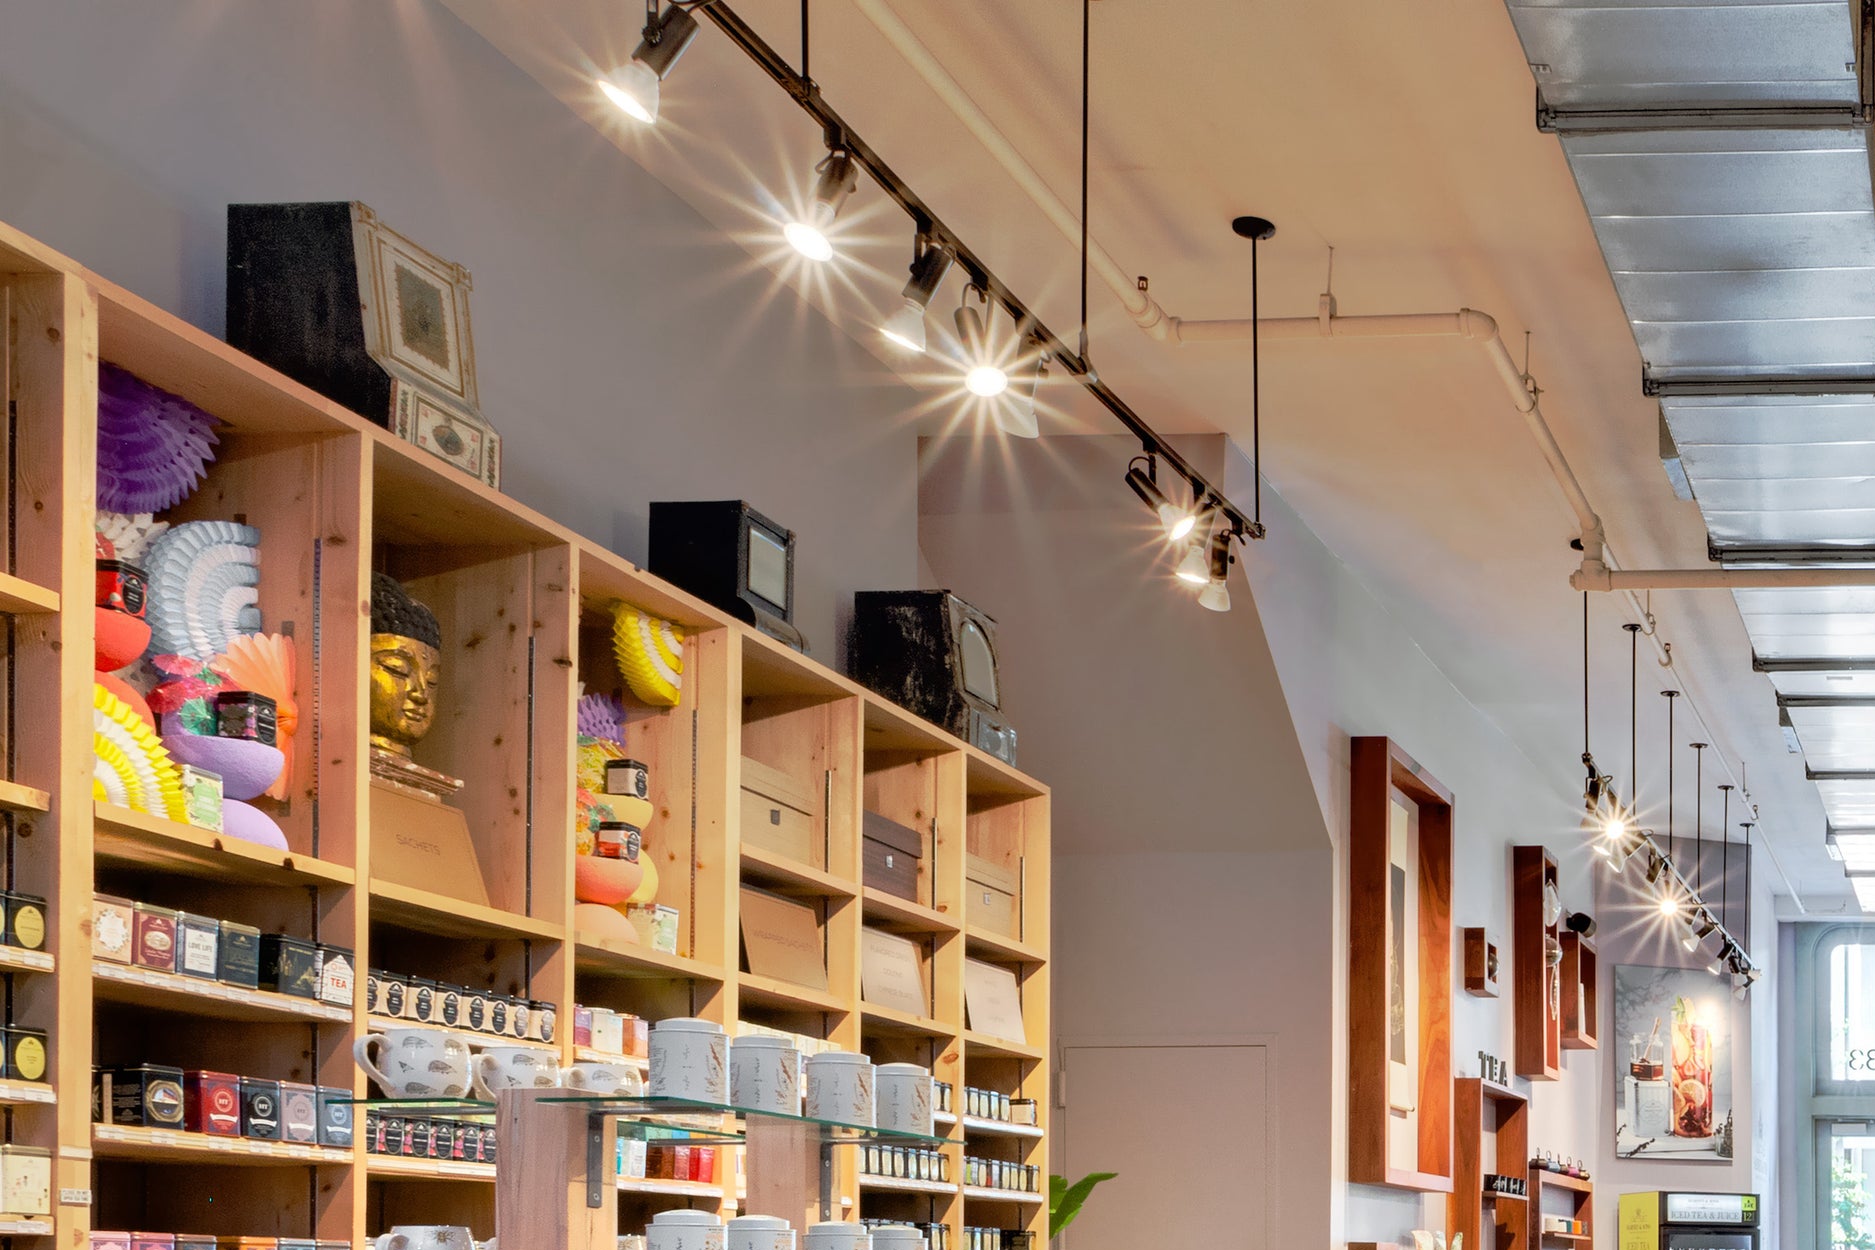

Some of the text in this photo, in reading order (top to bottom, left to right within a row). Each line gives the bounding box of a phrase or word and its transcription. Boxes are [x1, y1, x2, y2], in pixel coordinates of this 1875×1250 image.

[395, 832, 441, 857] SACHETS
[329, 977, 347, 989] TEA
[1478, 1050, 1508, 1088] TEA
[1670, 1209, 1740, 1221] ICED TEA & JUICE
